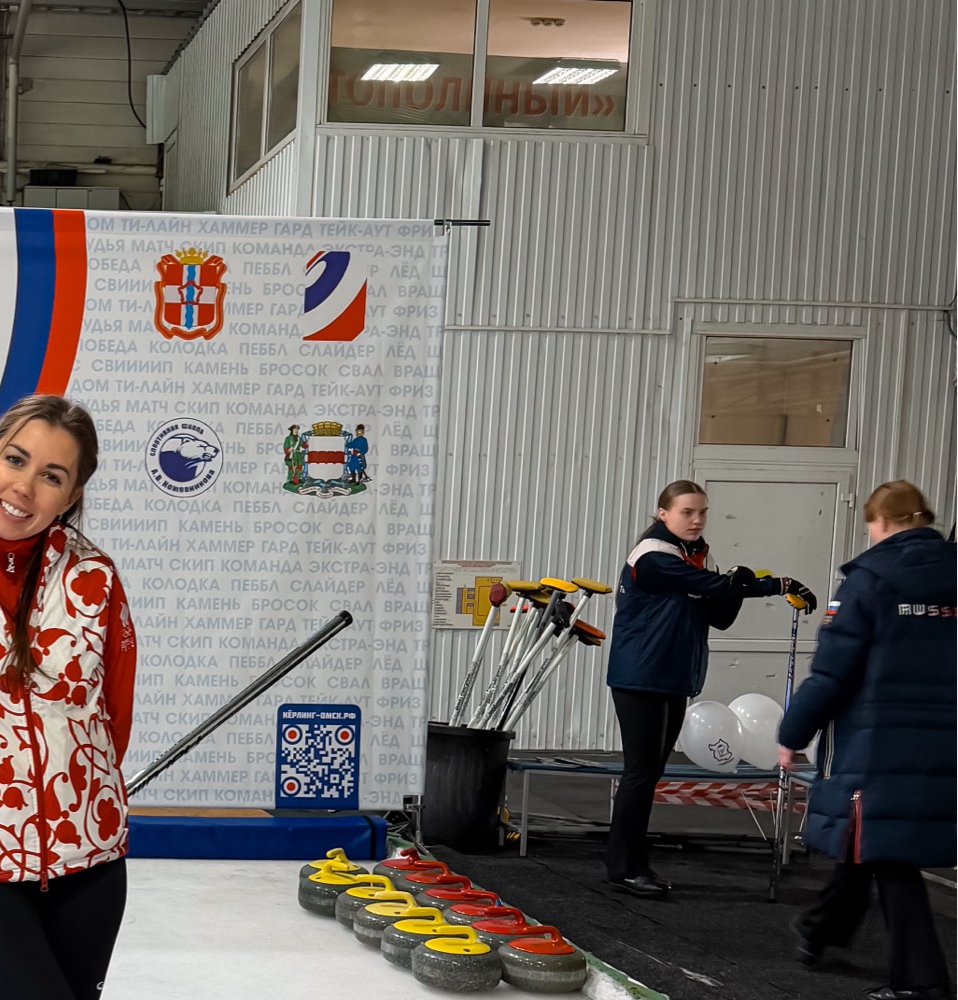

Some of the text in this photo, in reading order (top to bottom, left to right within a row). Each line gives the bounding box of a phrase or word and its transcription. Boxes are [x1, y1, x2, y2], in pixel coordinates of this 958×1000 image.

[121, 217, 191, 233] ТИ-ЛАЙН
[198, 220, 268, 235] ХАММЕР
[274, 223, 313, 238] ГАРД
[319, 221, 391, 237] ТЕЙК-АУТ
[398, 224, 433, 237] ФРИ
[132, 240, 174, 253] МАТЧ
[90, 258, 420, 279] ОБЕДА ПЕББЛ ЛЁД
[394, 305, 437, 317] ФРИЗ
[149, 341, 228, 356] КОЛОДКА
[239, 343, 287, 356] ПЕББЛ
[299, 342, 375, 359] СЛАЙДЕР
[386, 343, 415, 360] ЛЁД
[92, 359, 173, 373] СВИИИИП
[184, 362, 248, 374] КАМЕНЬ
[260, 363, 328, 377] БРОСОК
[339, 365, 383, 377] СВАЛ
[116, 377, 185, 393] ТИ-ЛАЙН
[192, 382, 261, 395] ХАММЕР
[267, 384, 304, 398] ГАРД
[312, 381, 383, 397] ТЕЙК-АУТ
[389, 385, 433, 397] ФРИЗ
[126, 401, 168, 413] МАТЧ
[174, 401, 219, 414] СКИП
[227, 403, 307, 418] КОМАНДА
[314, 404, 417, 419] ЭКСТРА-ЭНД
[236, 422, 283, 435] ПЕББЛ
[382, 421, 411, 439] ЛЁД
[386, 464, 429, 476] ФРИЗ
[144, 499, 408, 517] КОЛОДКА ПЕББЛ СЛАЙДЕР ЛЁД
[88, 518, 167, 532] СВИИИИП
[179, 520, 242, 533] КАМЕНЬ
[254, 521, 321, 534] БРОСОК
[333, 522, 376, 535] СВАЛ
[111, 536, 426, 555] ТИ-ЛАЙН ХАММЕР ГАРД ТЕЙК-АУТ ФРИЗ
[121, 558, 410, 576] МАТЧ СКИП КОМАНДА ЭКСТРА-ЭНД
[143, 577, 405, 596] КОЛОДКА ПЕББЛ СЛАЙДЕР ЛЁД
[177, 597, 240, 610] КАМЕНЬ
[252, 599, 318, 612] БРОСОК
[185, 617, 252, 630] ХАММЕР
[259, 618, 296, 632] ГАРД
[379, 620, 423, 632] ФРИЗ
[167, 636, 212, 649] СКИП
[141, 655, 217, 669] КОЛОДКА
[230, 656, 274, 668] ПЕББЛ
[373, 655, 402, 672] ЛЁД
[175, 675, 238, 687] КАМЕНЬ
[328, 677, 370, 689] СВАЛ
[377, 697, 420, 708] ФРИЗ
[282, 710, 356, 719] КЁРЛИНГ-ОМСК.РФ
[227, 732, 399, 749] ПЕББЛ ЛЁД
[181, 771, 417, 785] ХАММЕР ФРИЗ
[164, 790, 208, 801] СКИП
